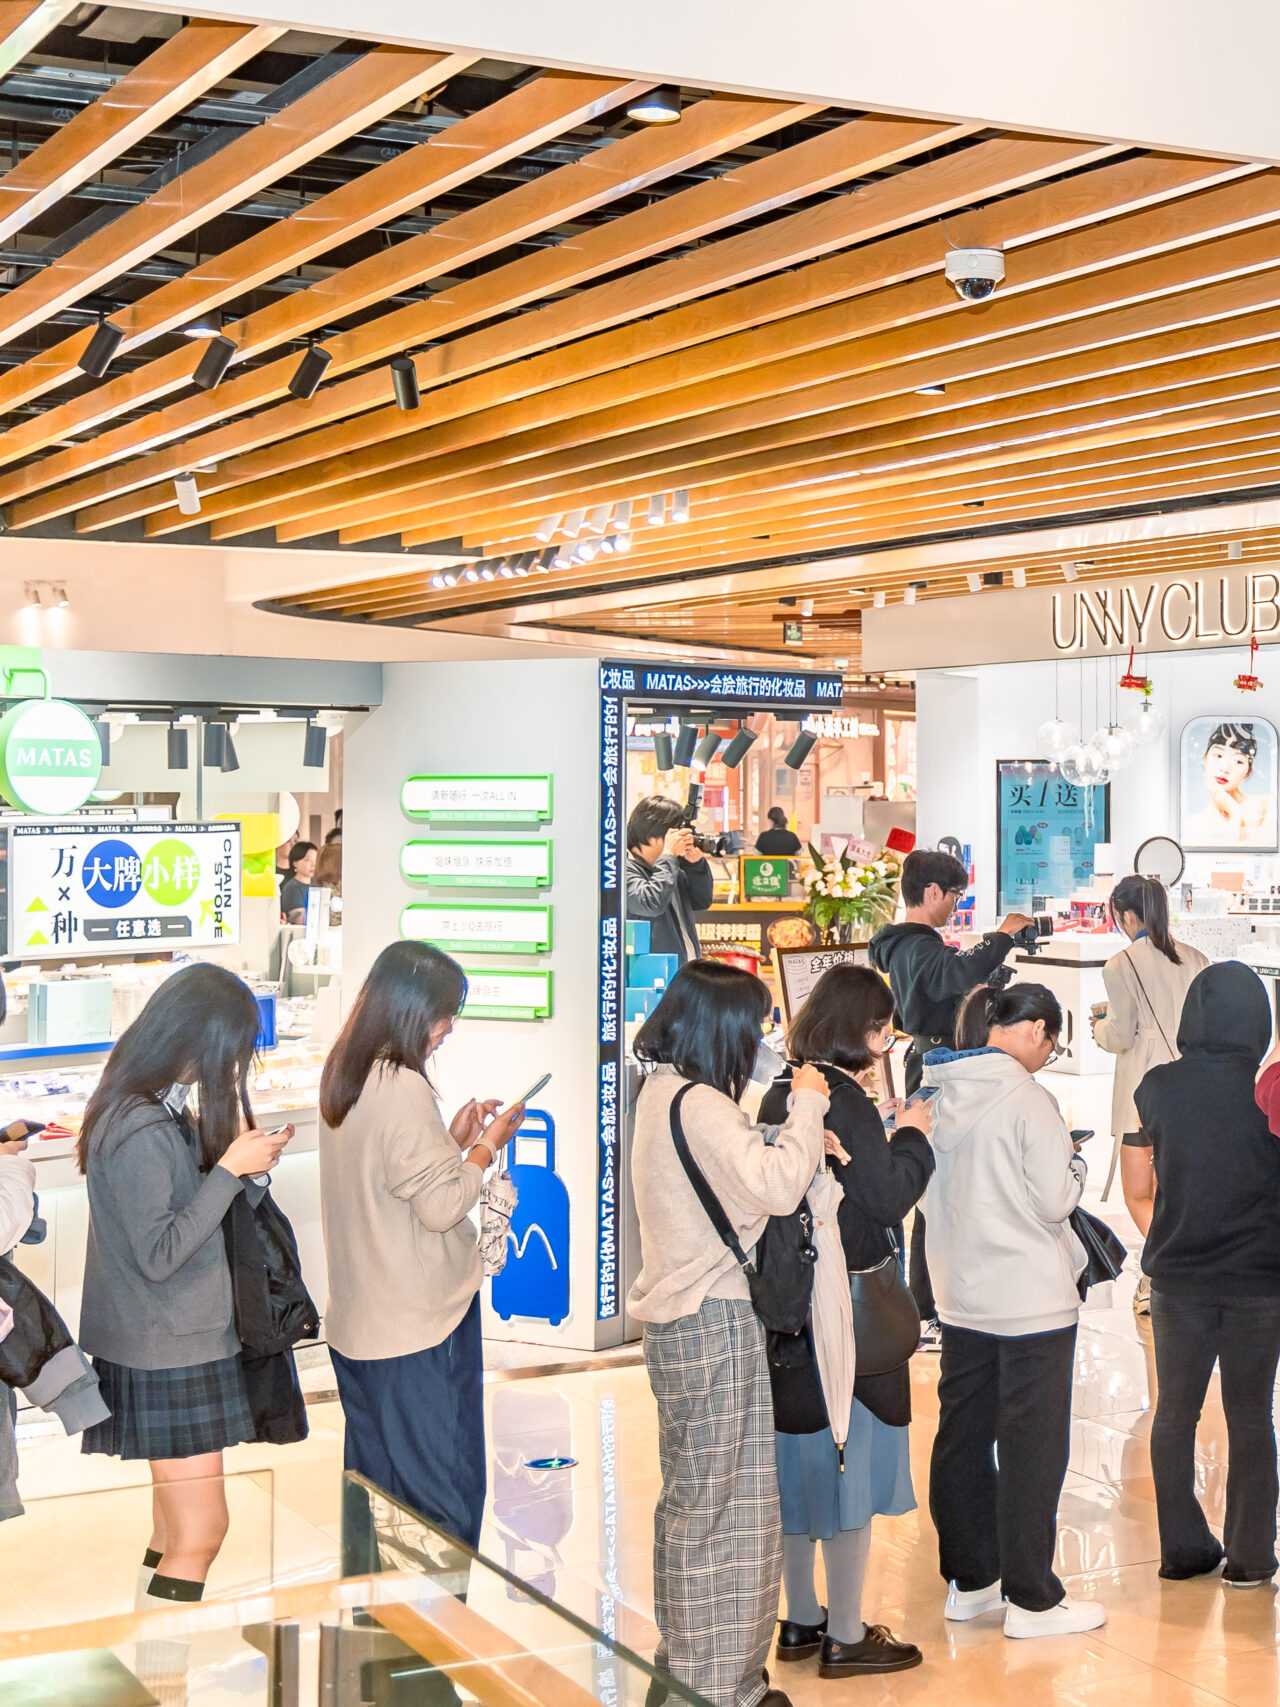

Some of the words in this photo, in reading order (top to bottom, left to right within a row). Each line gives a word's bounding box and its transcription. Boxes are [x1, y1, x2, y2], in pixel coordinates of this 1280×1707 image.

[16, 747, 92, 767] MATAS
[17, 827, 41, 835] MATAS
[174, 825, 197, 833] MATAS
[83, 855, 200, 893] 大牌小样
[223, 838, 232, 908] CHAIN
[214, 861, 223, 939] STORE
[115, 918, 162, 938] 任意选
[601, 917, 617, 1042] 旅行的化妆品
